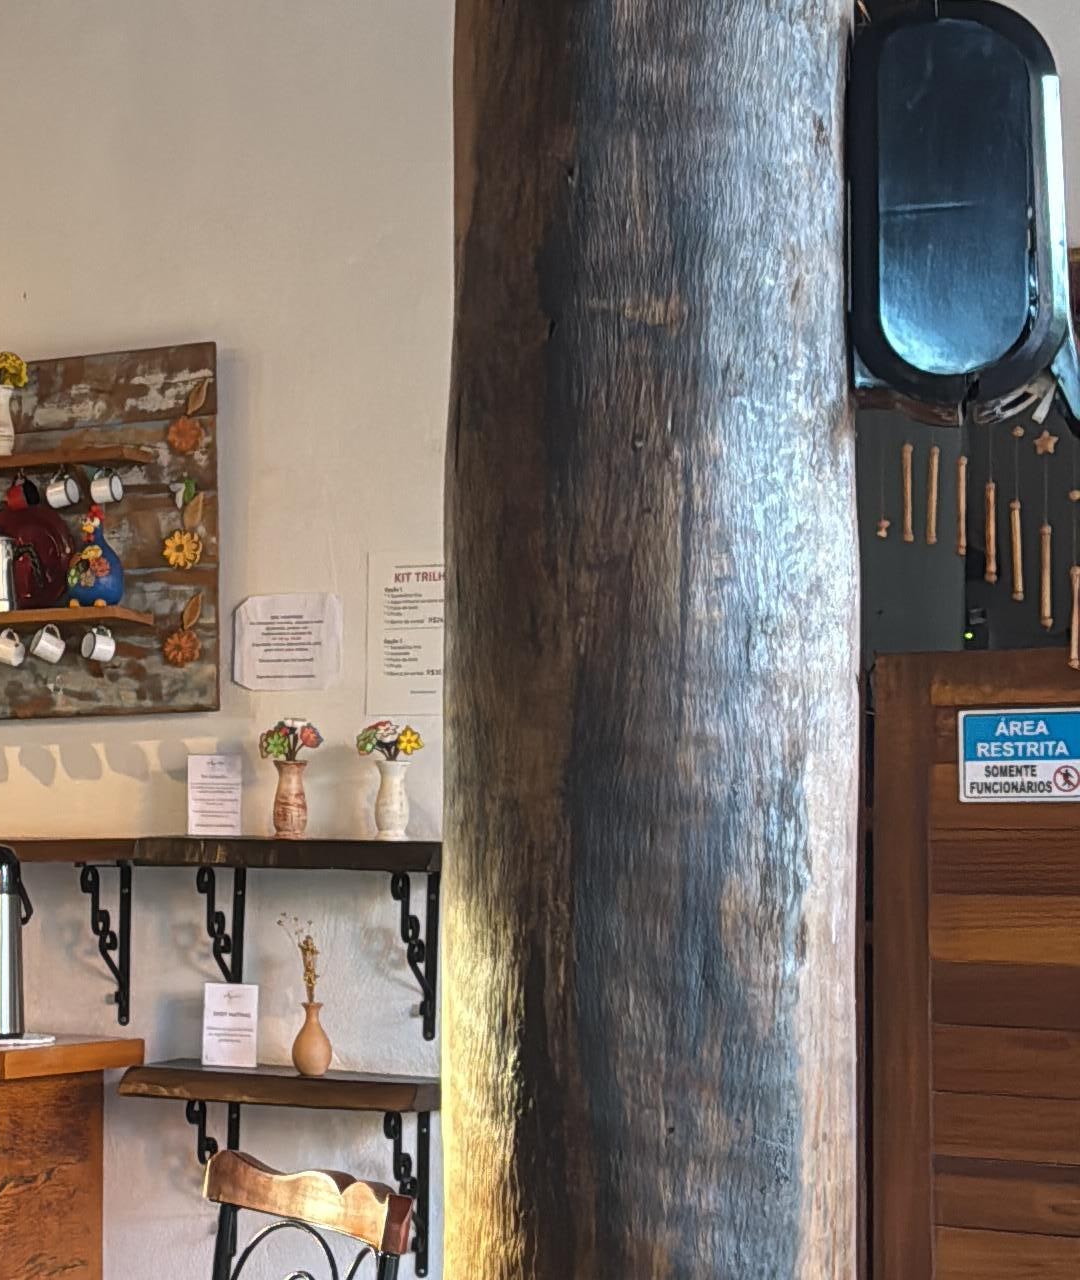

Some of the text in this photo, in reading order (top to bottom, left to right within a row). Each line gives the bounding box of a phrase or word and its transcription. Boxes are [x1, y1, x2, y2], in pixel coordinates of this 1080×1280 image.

[394, 570, 445, 584] KIT TRILH
[995, 717, 1049, 736] ÁREA
[976, 740, 1070, 758] RESTRITA
[984, 765, 1038, 778] SOMENTE
